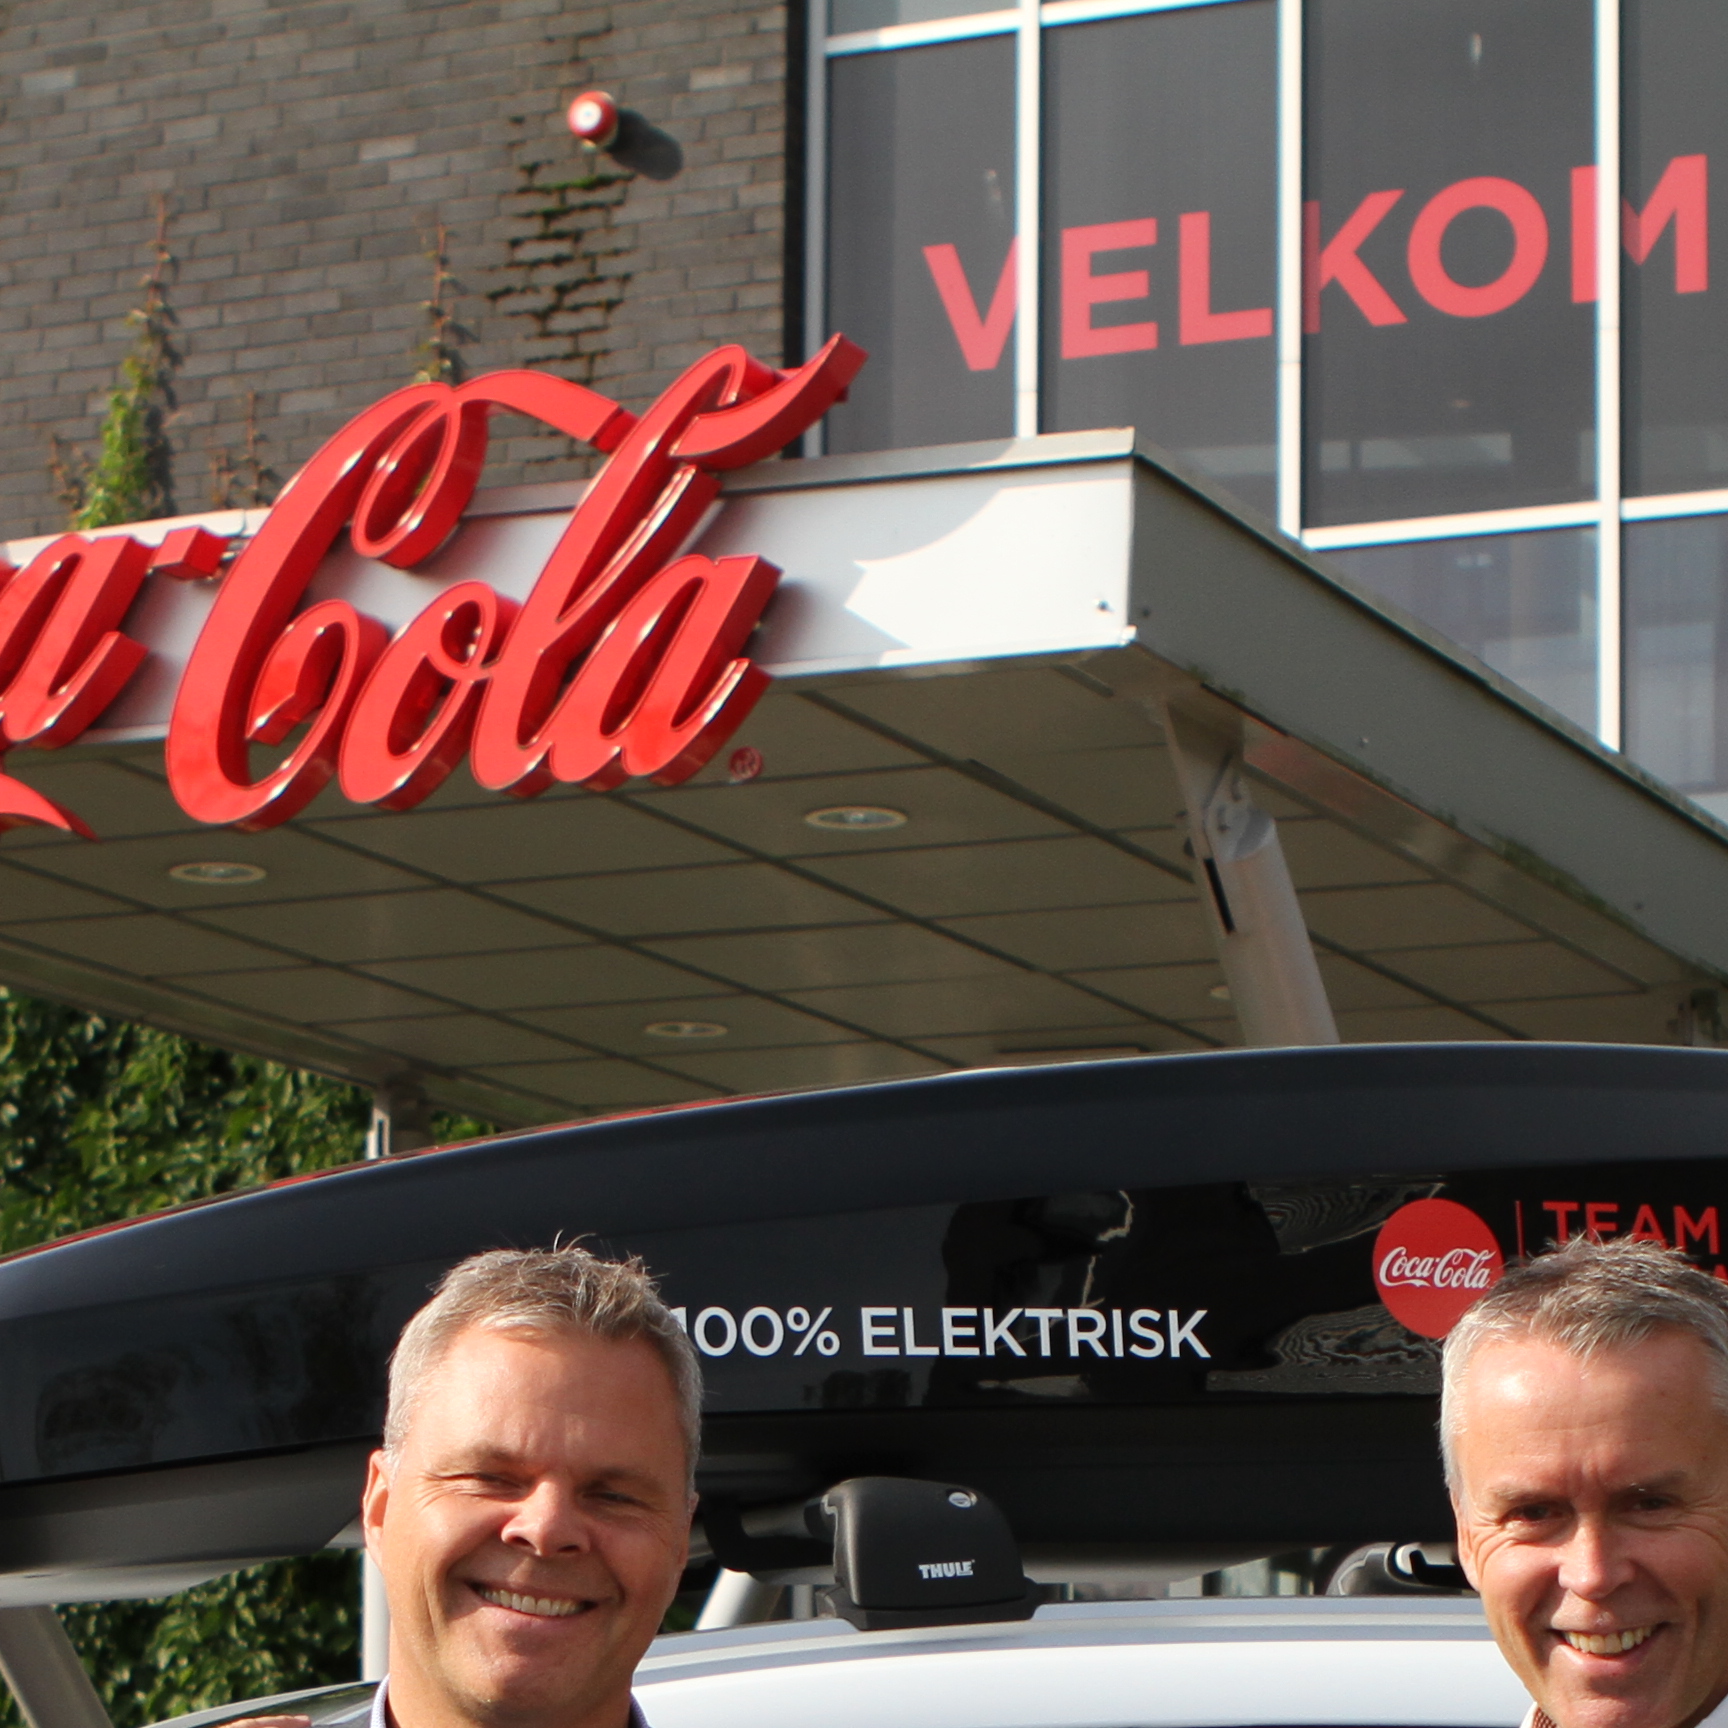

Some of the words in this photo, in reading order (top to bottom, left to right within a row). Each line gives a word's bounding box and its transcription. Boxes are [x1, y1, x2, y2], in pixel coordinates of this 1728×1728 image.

[1543, 1201, 1719, 1255] TEAM
[1379, 1246, 1497, 1289] Coca-Cola
[861, 1306, 1212, 1358] ELEKTRISK
[918, 1560, 974, 1579] THULE
